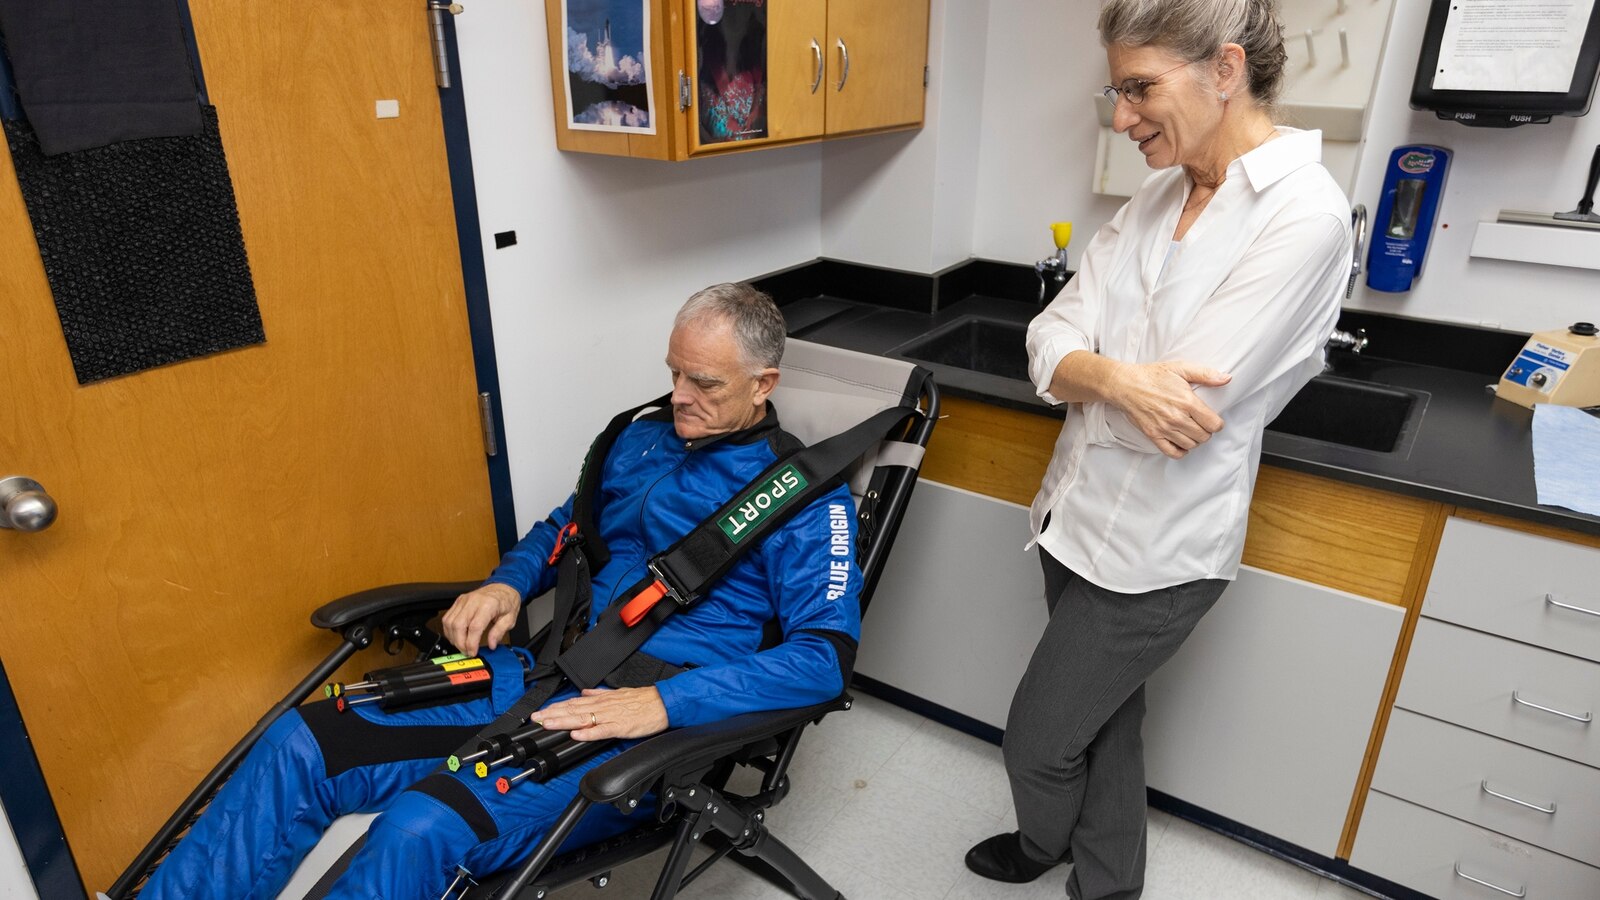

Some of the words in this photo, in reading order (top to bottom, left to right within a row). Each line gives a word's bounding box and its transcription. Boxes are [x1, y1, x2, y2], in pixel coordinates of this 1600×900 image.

[728, 471, 799, 536] SPORT
[829, 504, 850, 556] ORIGIN
[826, 561, 850, 601] BLUE
